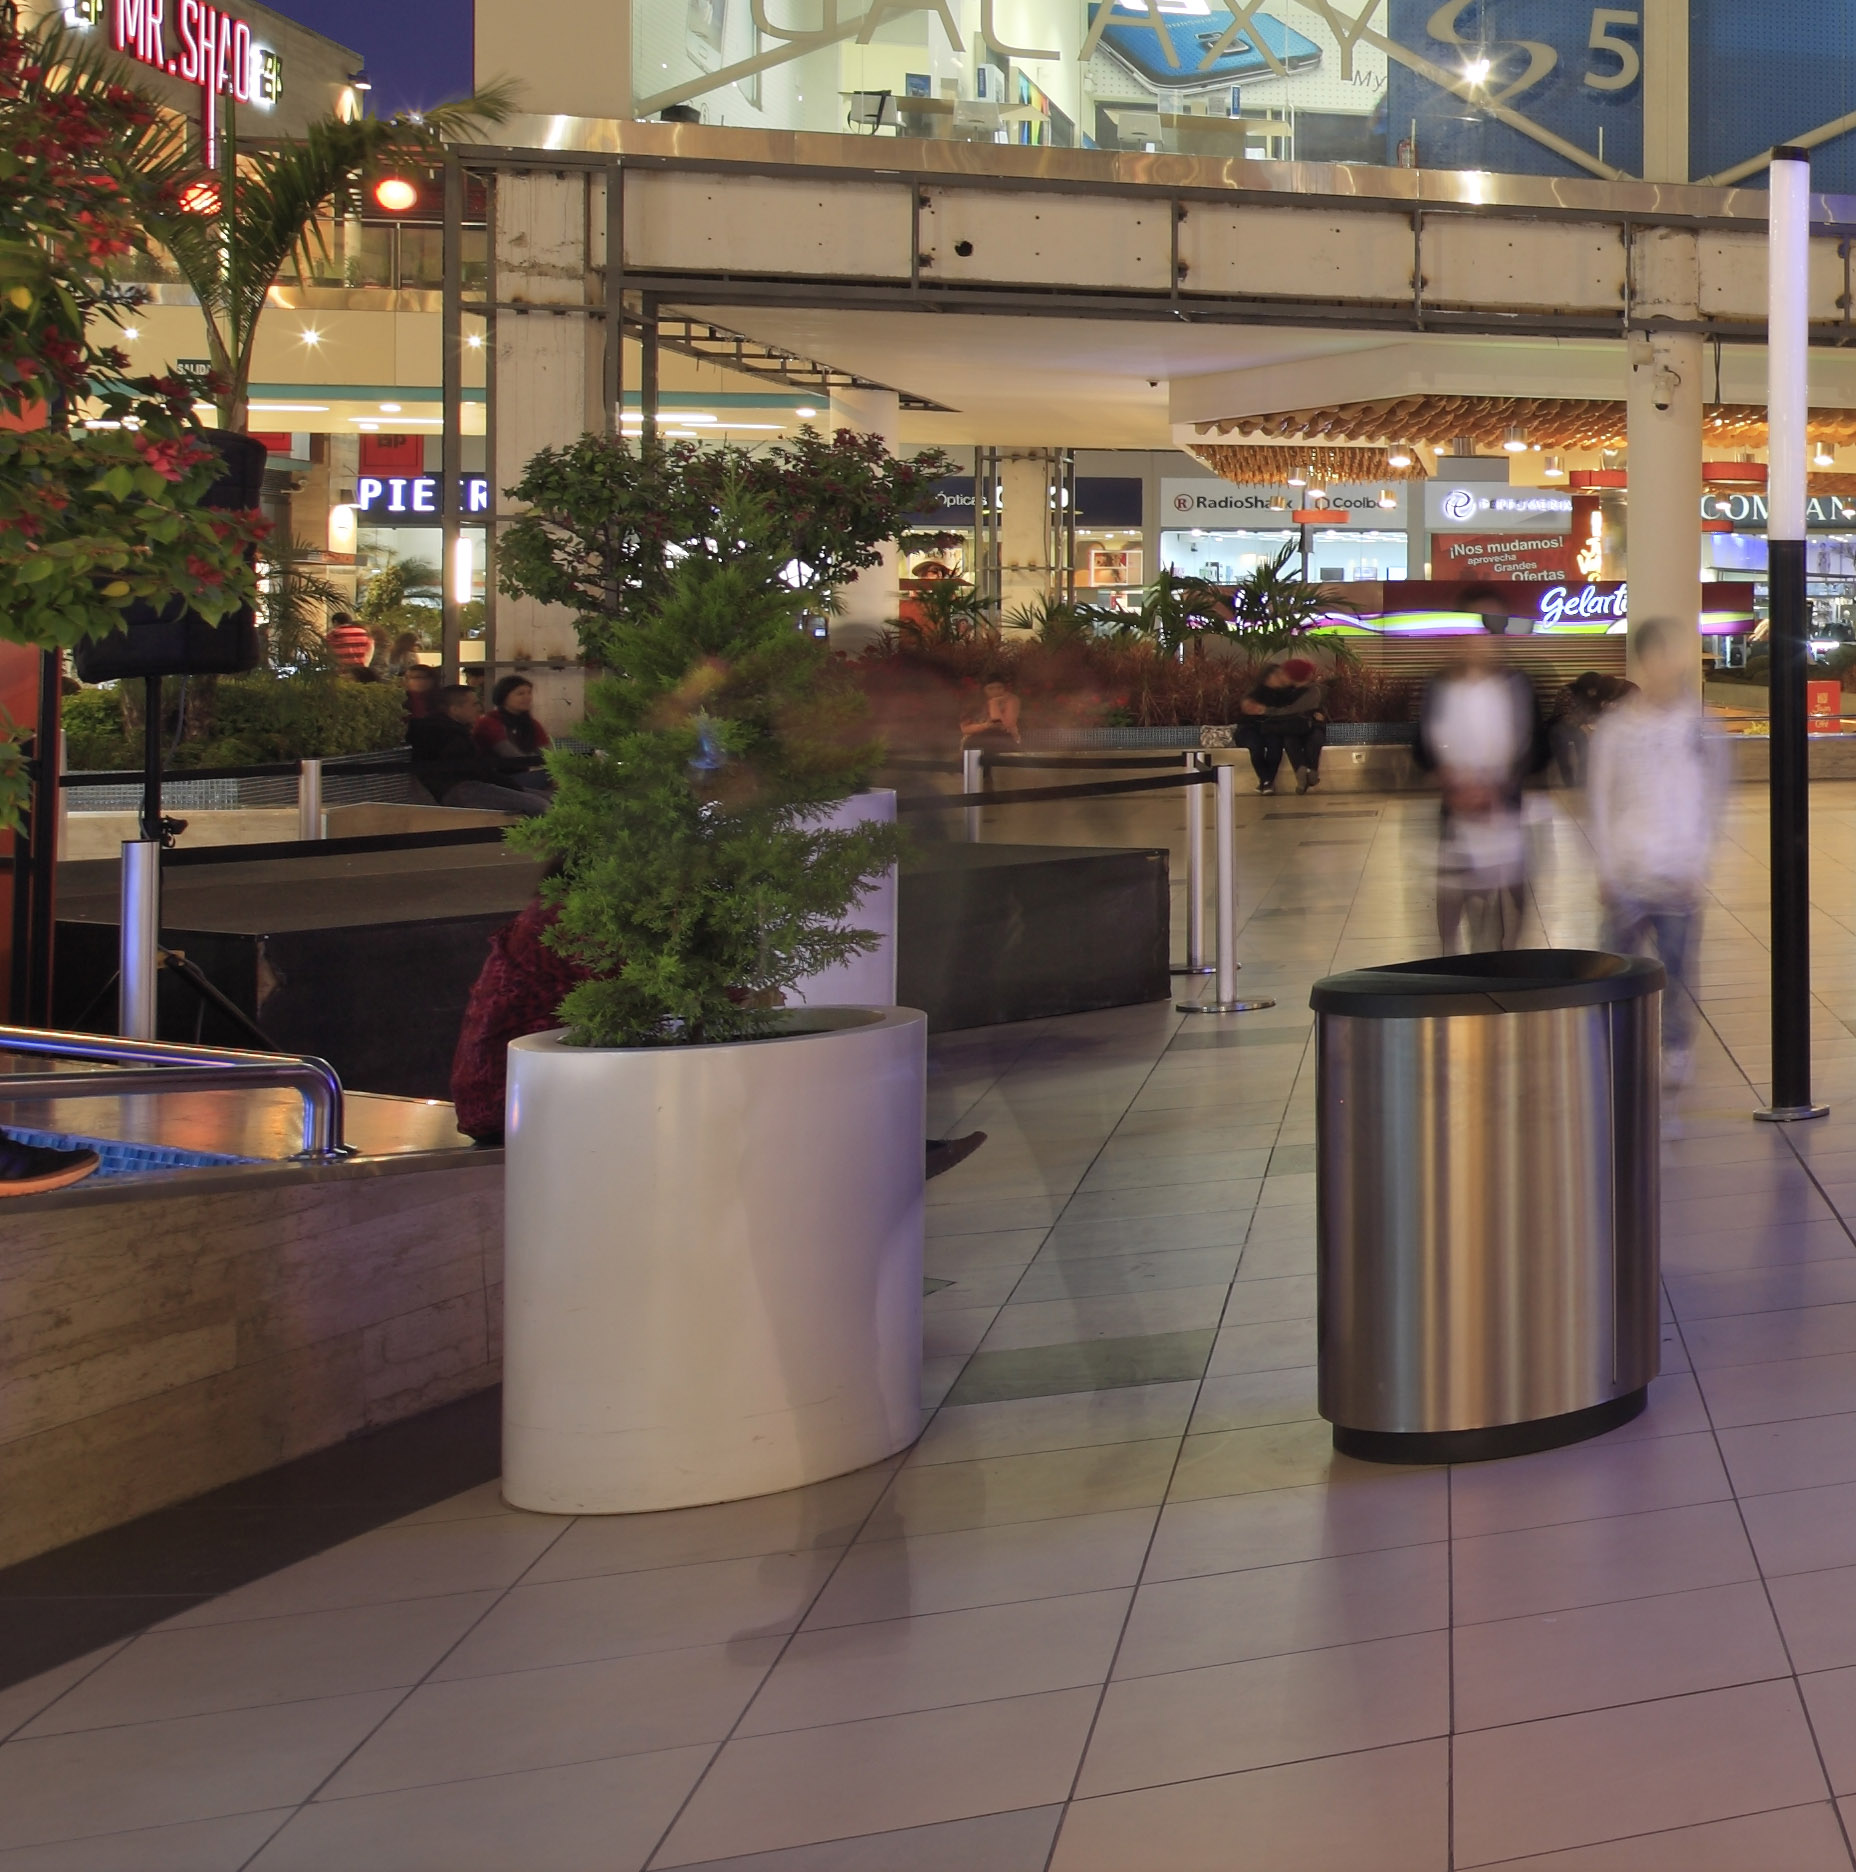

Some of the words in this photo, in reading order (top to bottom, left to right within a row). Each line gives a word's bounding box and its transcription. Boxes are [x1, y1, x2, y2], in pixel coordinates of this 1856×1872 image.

[1196, 495, 1293, 509] RadioShak
[1487, 536, 1564, 554] mudamos!
[1493, 561, 1537, 573] Grandes
[1511, 568, 1566, 581] Ofertas
